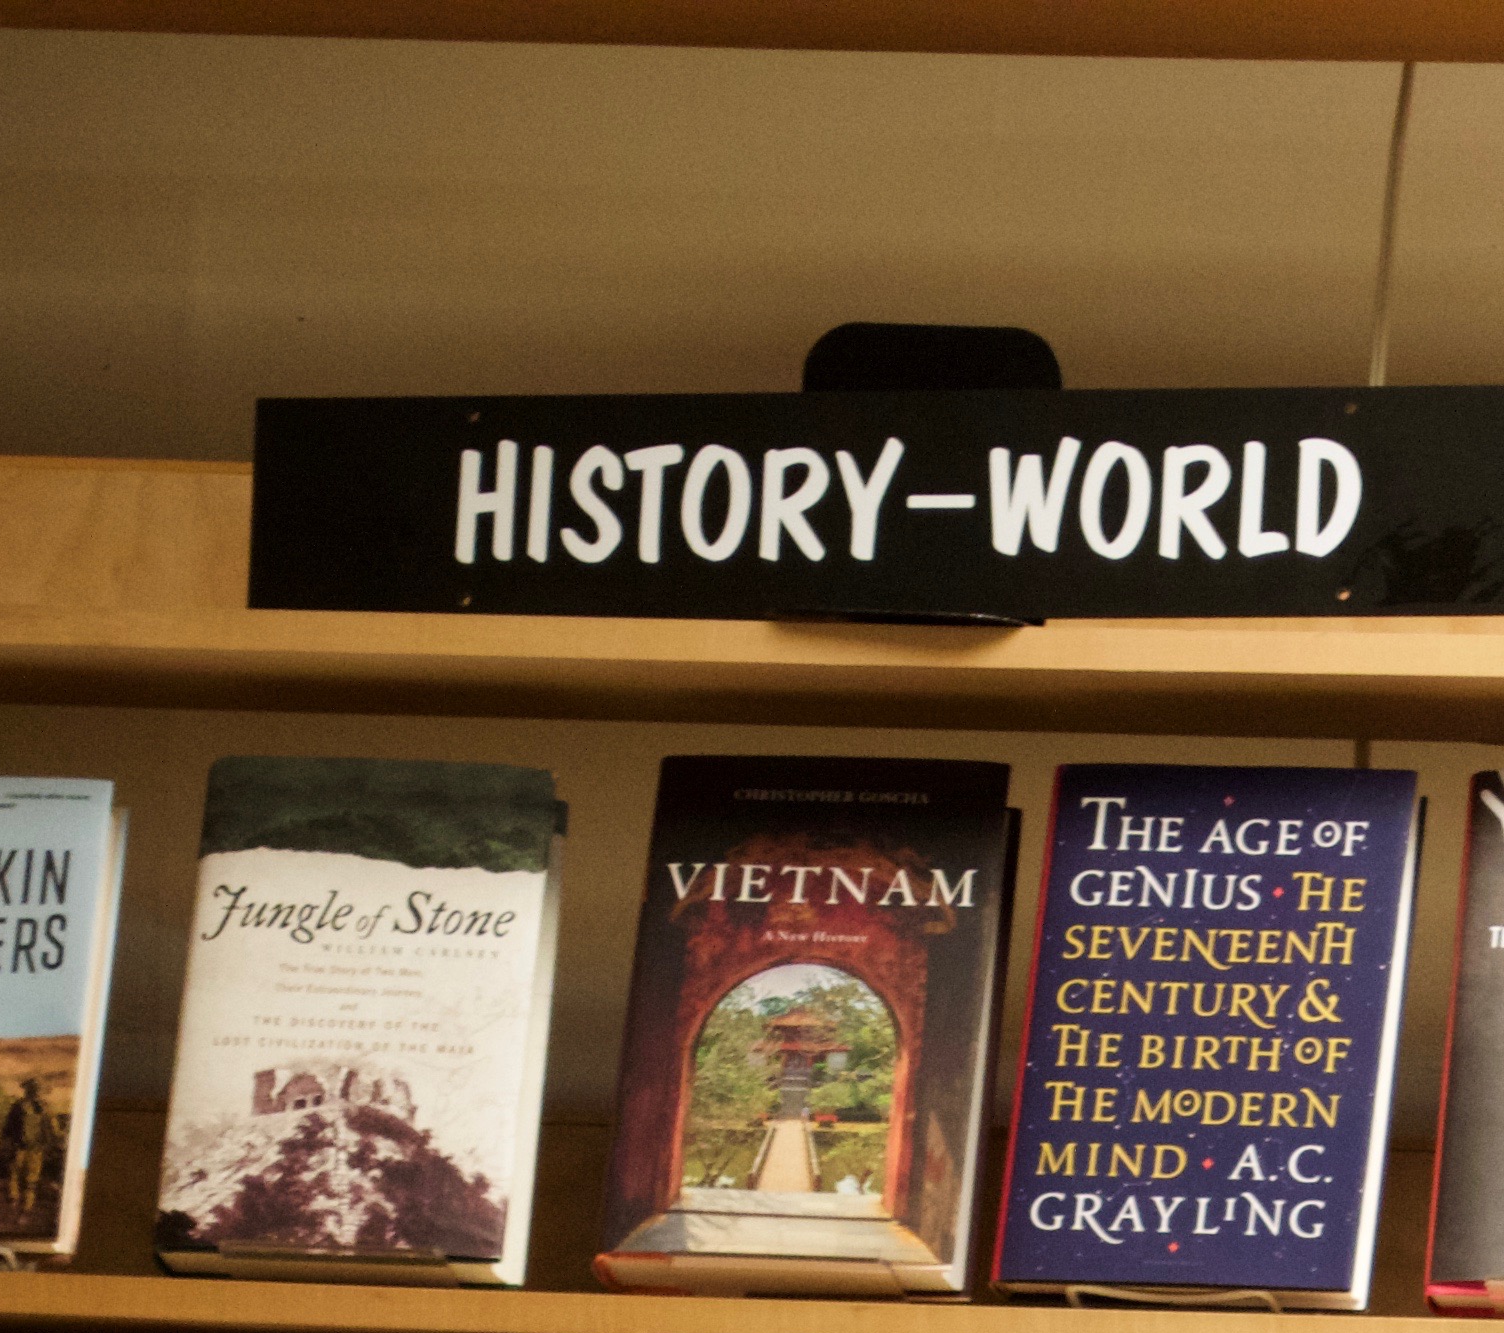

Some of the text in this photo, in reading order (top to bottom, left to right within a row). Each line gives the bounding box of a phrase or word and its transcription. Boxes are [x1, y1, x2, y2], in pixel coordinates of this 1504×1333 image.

[453, 436, 1364, 566] HISTORY-WORLD
[1081, 797, 1370, 858] THE AGE OF
[666, 861, 978, 908] VIETNAM
[1069, 867, 1366, 913] GENIUS THE
[201, 883, 517, 945] Jungle of Stone
[1062, 923, 1356, 972] SEVENTEENTH
[1056, 979, 1342, 1029] CENTURY &
[1051, 1025, 1353, 1074] THE BIRTH OF
[1045, 1081, 1341, 1131] THE MODERN
[1036, 1142, 1334, 1183] MIND A.C.
[1029, 1192, 1327, 1246] GRAYLING
